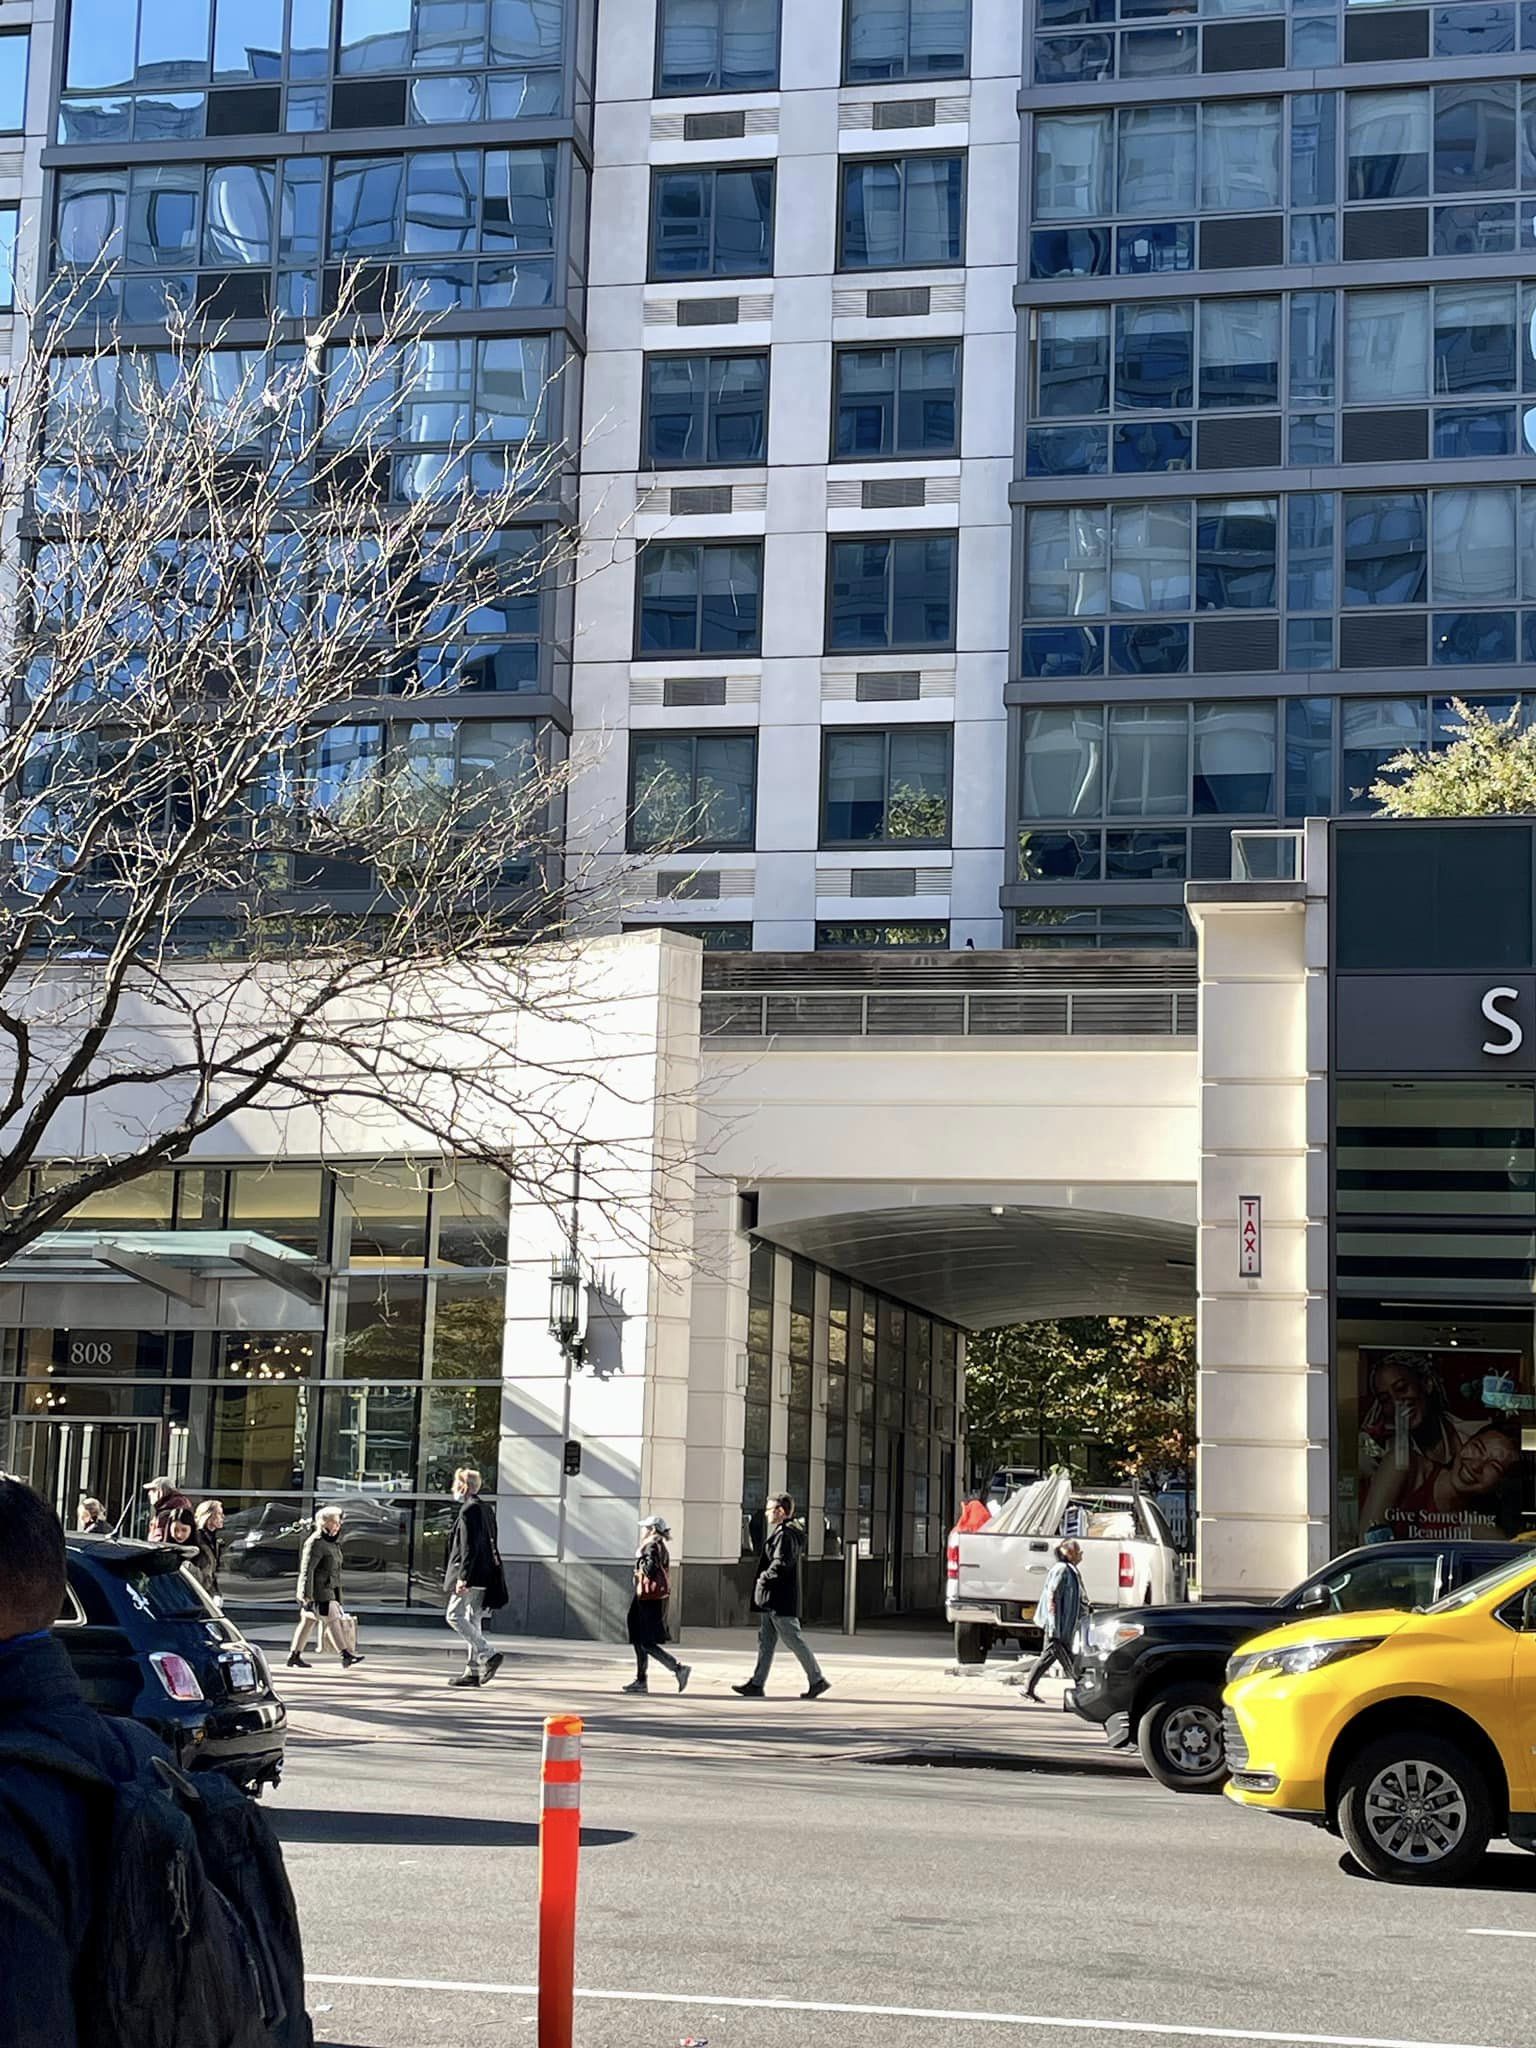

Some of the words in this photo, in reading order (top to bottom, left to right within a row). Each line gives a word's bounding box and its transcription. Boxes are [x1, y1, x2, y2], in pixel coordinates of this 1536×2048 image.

[1482, 987, 1522, 1054] S
[71, 1342, 112, 1365] 808
[1384, 1507, 1416, 1522] Give
[1419, 1509, 1497, 1528] Something
[1408, 1524, 1472, 1540] Beautiful
